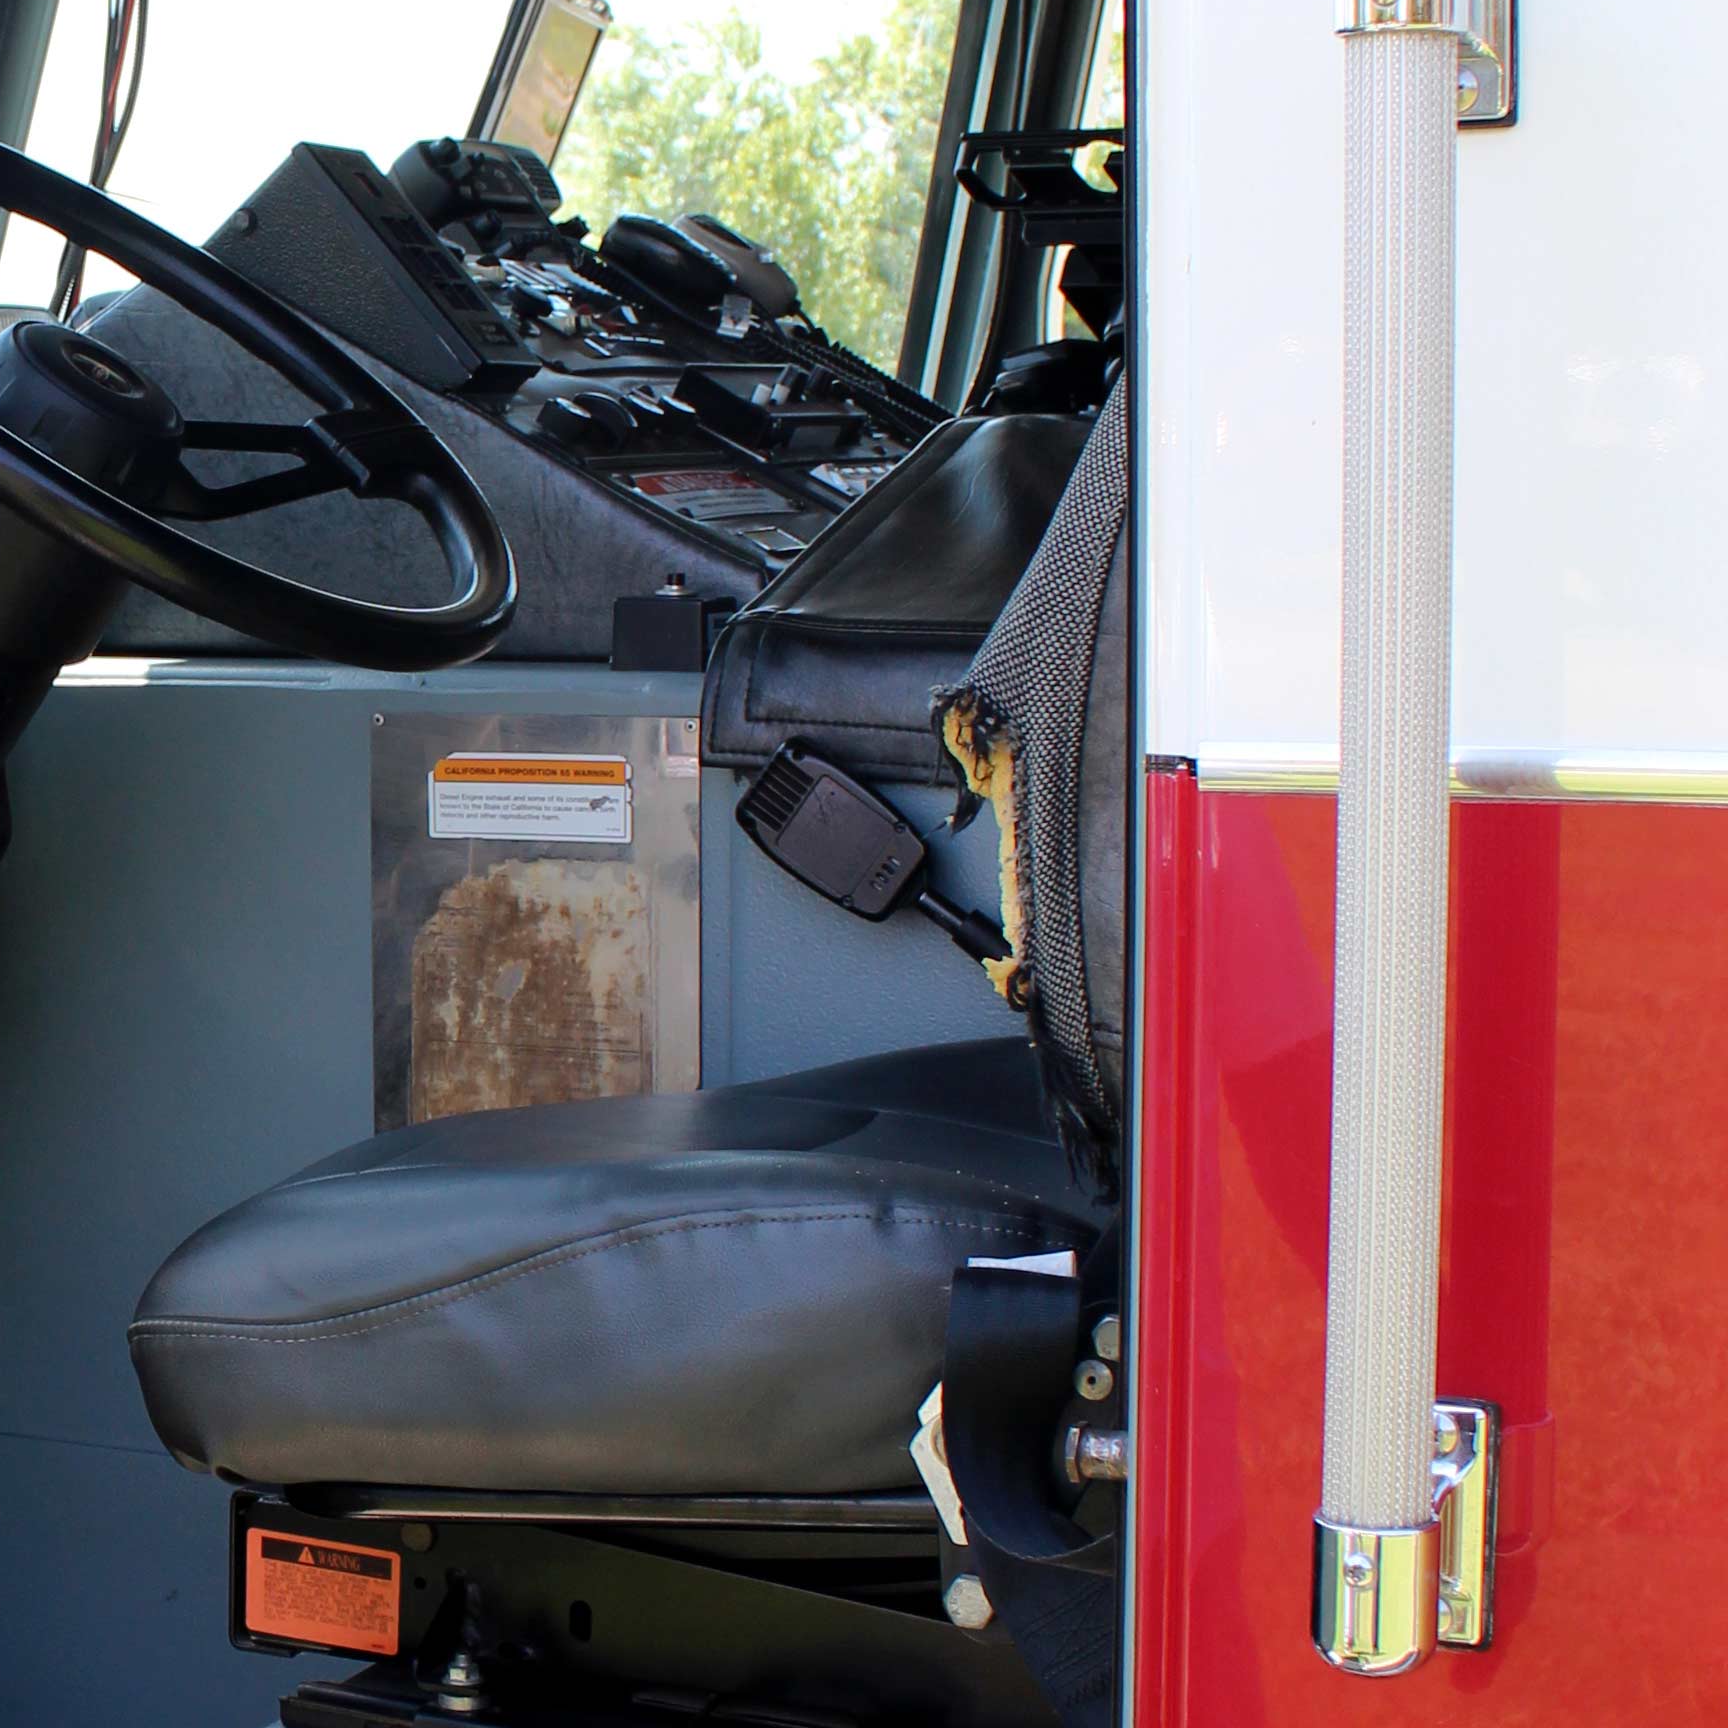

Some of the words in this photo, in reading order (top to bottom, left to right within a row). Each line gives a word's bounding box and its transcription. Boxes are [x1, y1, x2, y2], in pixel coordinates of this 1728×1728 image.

[445, 767, 496, 776] CALIFORNIA
[498, 767, 557, 777] PROPOSITION
[559, 768, 571, 777] 65
[573, 769, 615, 778] WARNING
[461, 793, 483, 801] Engine
[511, 803, 543, 811] California
[318, 1550, 361, 1571] WARNING
